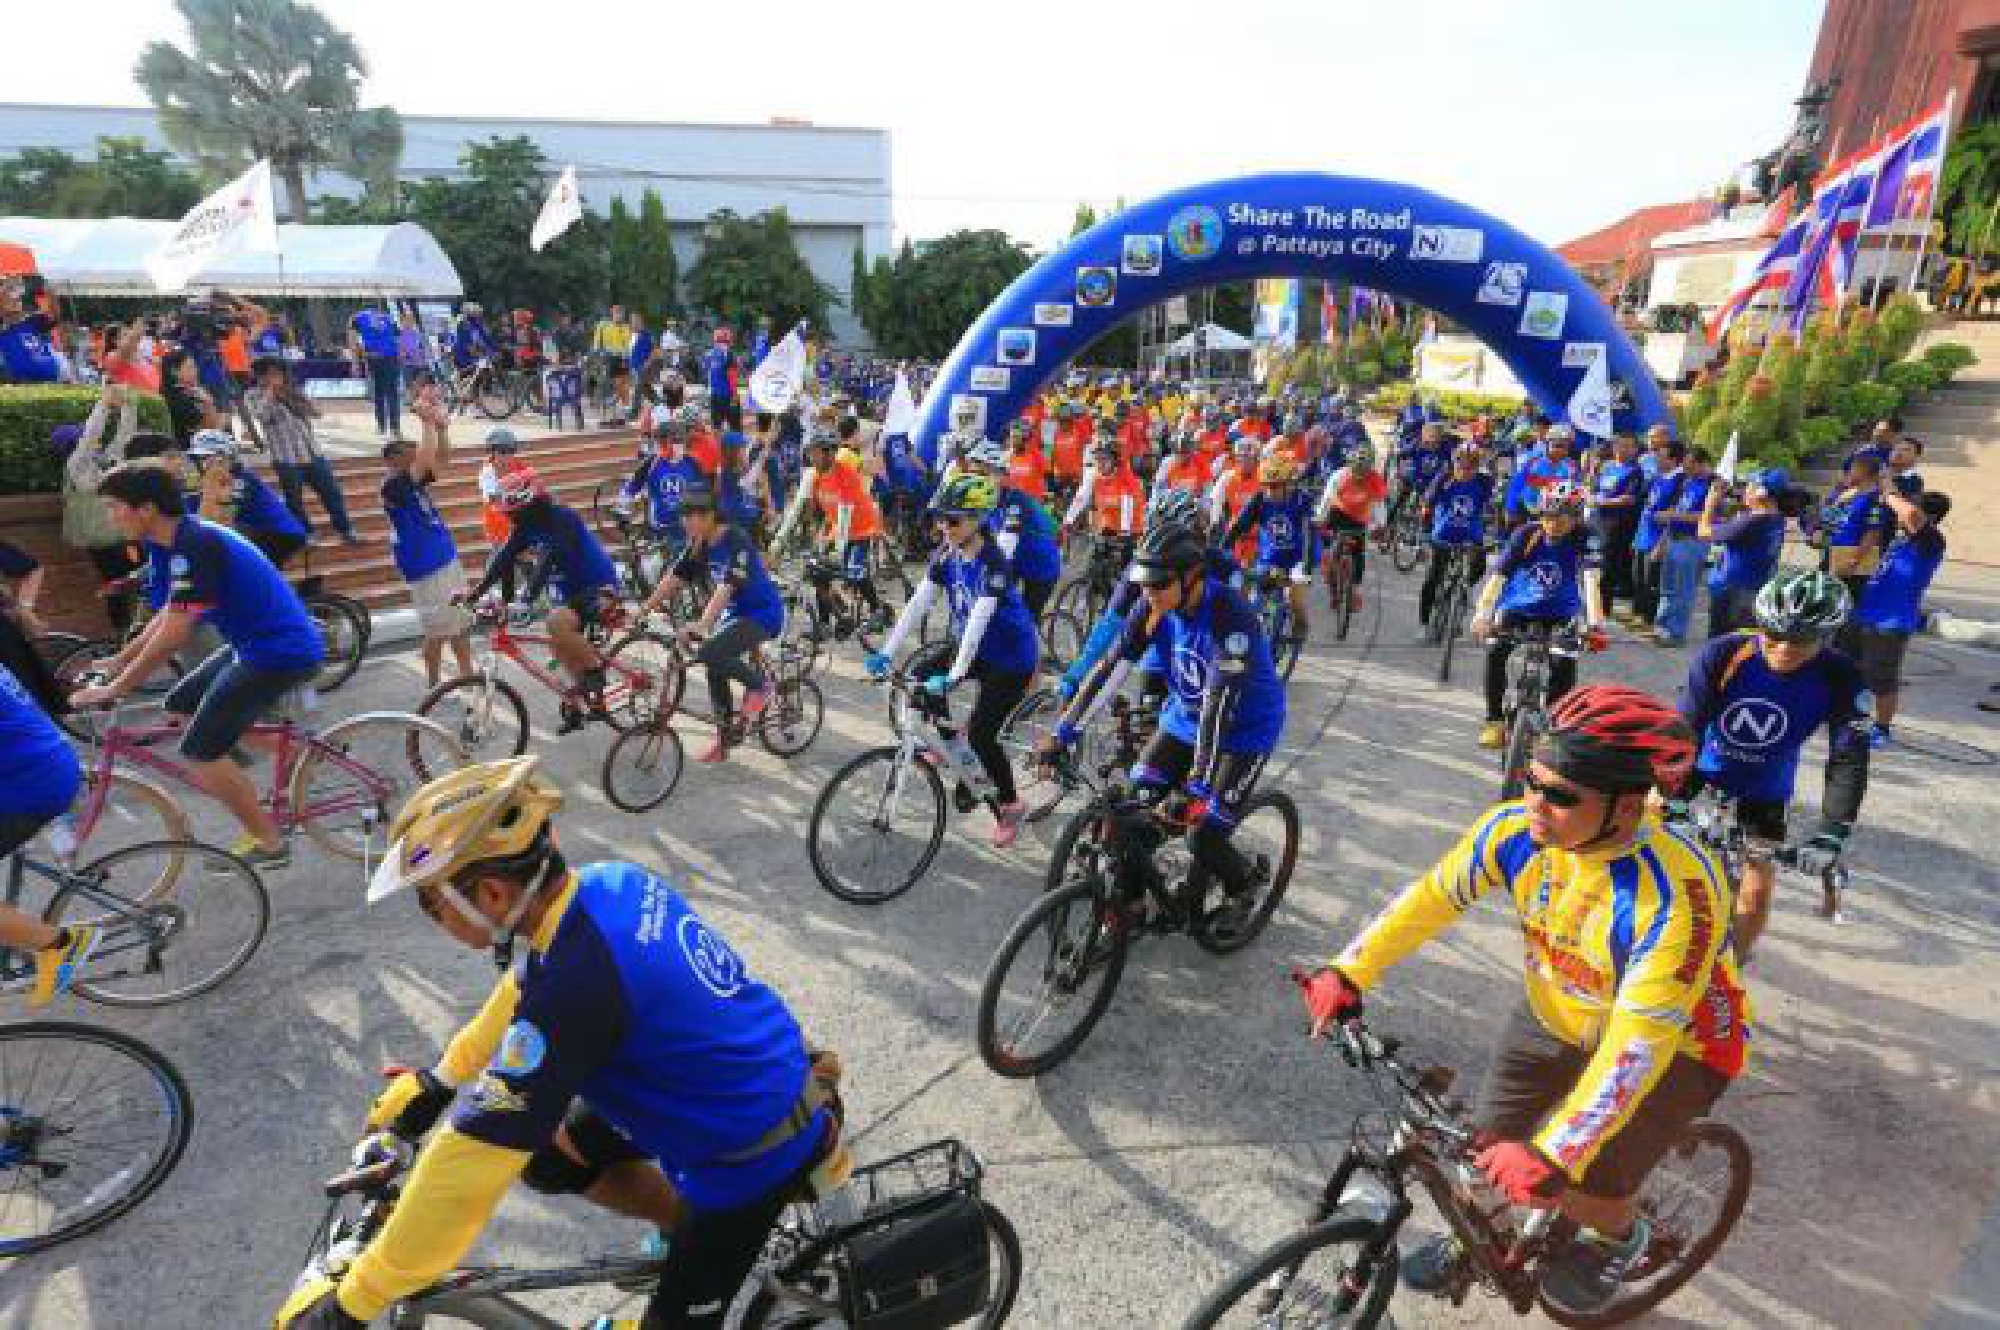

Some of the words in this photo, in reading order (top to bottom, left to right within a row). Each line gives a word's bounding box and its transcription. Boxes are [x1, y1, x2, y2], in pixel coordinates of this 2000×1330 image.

[1228, 202, 1293, 227] Share
[1304, 205, 1348, 230] The
[1351, 208, 1411, 231] Road
[1262, 233, 1344, 258] Pattaya
[1351, 236, 1397, 261] City
[1730, 707, 1777, 741] N
